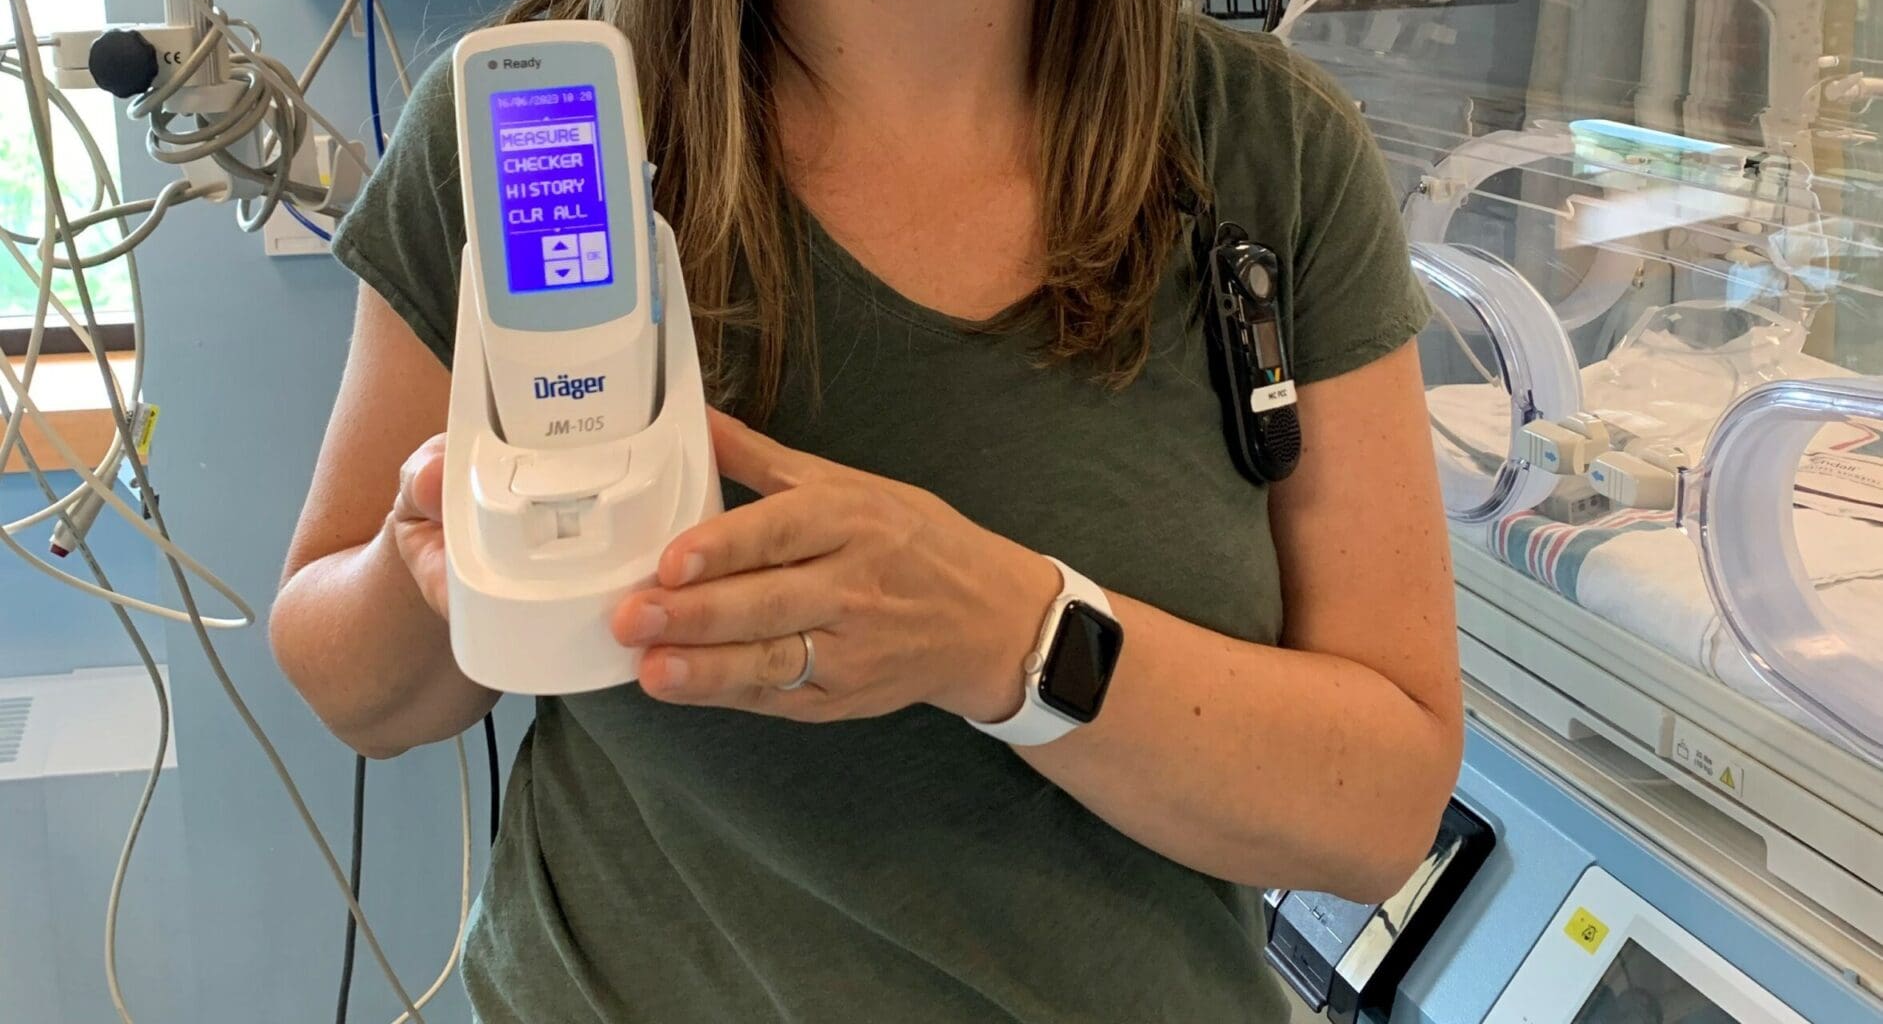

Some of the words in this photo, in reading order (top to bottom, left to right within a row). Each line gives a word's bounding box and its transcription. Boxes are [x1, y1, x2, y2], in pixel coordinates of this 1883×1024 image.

[503, 56, 542, 70] Ready
[502, 127, 580, 148] MEASURE
[503, 152, 584, 174] CHECKER
[506, 178, 585, 199] HISTORY
[508, 207, 544, 225] CLR
[553, 204, 588, 221] ALL
[533, 374, 606, 400] Dräger
[545, 415, 605, 437] JM-105
